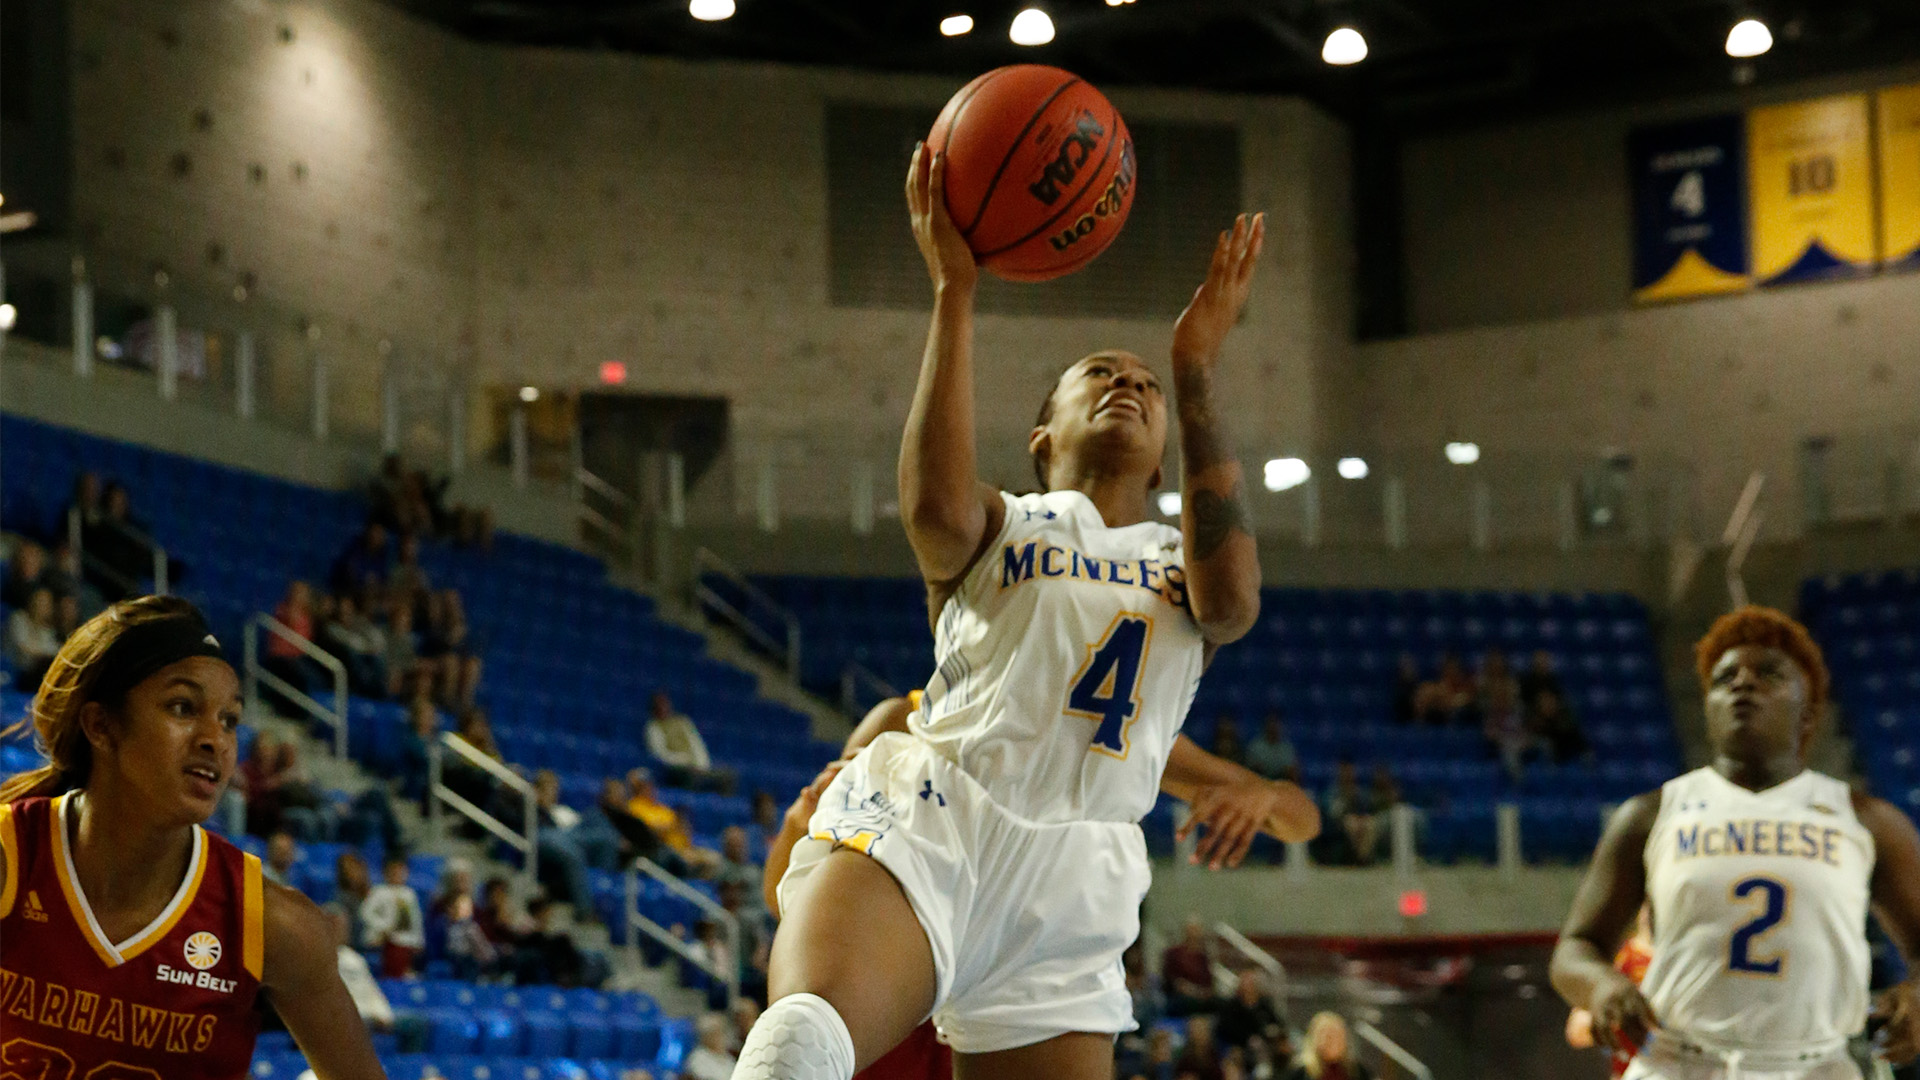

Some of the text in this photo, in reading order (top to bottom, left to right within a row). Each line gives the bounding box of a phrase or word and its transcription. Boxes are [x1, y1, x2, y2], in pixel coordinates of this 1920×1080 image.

[1029, 109, 1105, 206] NCAA
[1050, 138, 1137, 251] Wilson
[1001, 539, 1189, 608] McNEES
[1063, 611, 1154, 760] 4
[1726, 874, 1791, 977] 2
